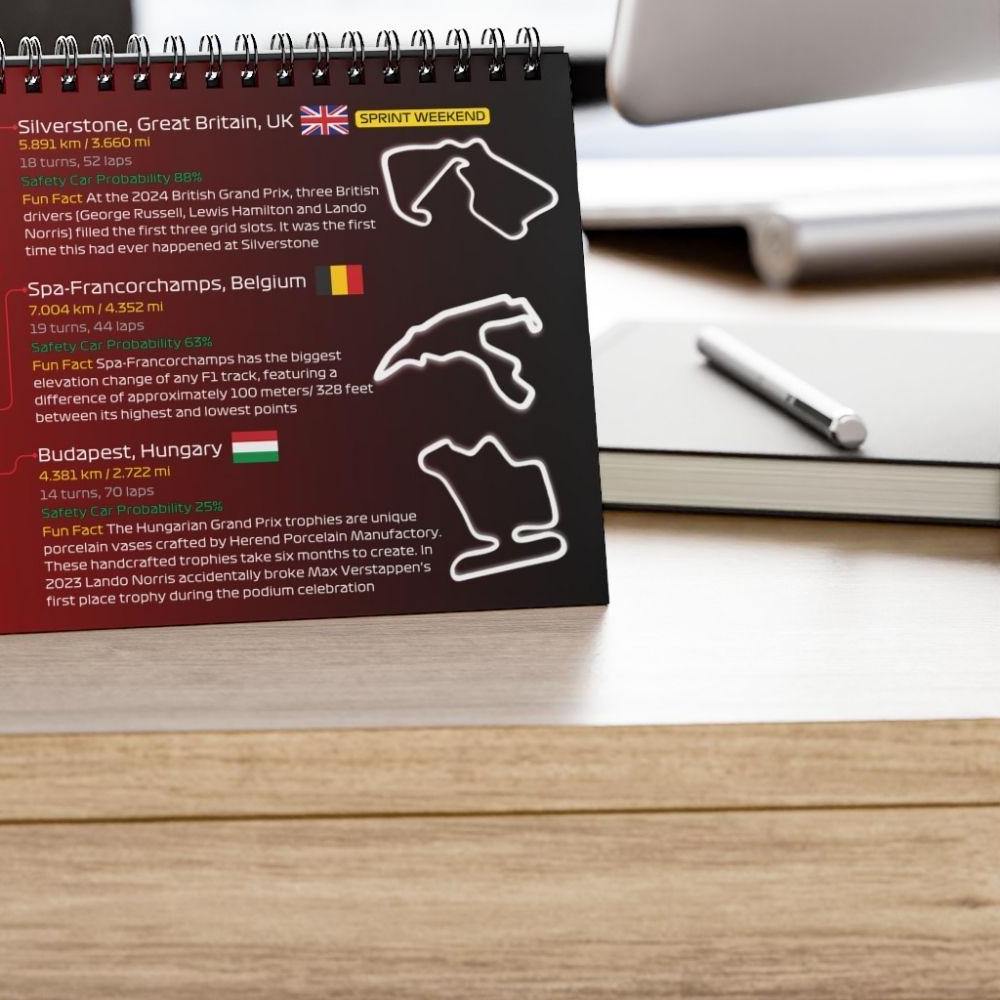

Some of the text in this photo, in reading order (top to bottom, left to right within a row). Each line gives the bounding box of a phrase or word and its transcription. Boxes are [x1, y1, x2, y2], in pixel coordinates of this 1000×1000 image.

[17, 113, 295, 135] Silverstone, Great Britain, UK
[359, 110, 486, 124] SPRINT WEEKEND
[22, 184, 380, 205] Fun Fact At the 2024 British Grand Prix, three British
[23, 202, 367, 223] drivers (George Russell, Lewis Hamilton and Lando
[24, 218, 377, 240] Norris) filled the first three grid slots. It was the first
[24, 237, 319, 257] time this had ever happened at Silverstone
[27, 274, 307, 300] Spa-Francorchamps, Belgium
[32, 349, 342, 372] Fun Fact Spa-Francorchamps has the biggest
[33, 367, 338, 389] elevation change of any F1 track, featuring a
[34, 382, 374, 406] difference of approximately 100 meters/ 328 feet
[35, 402, 298, 424] between its highest and lowest points
[36, 442, 223, 464] Budapest, Hungary
[42, 511, 417, 538] Fun Fact The Hungarian Grand Prix trophies are unique
[43, 527, 443, 557] porcelain vases crafted by Herend Porcelain Manufactory.
[43, 544, 433, 573] These handcrafted trophies take six months to create. In
[44, 561, 432, 590] 2023 Lando Norris accidentally broke Max Verstappen's
[45, 581, 375, 608] first place trophy during the podium celebration
